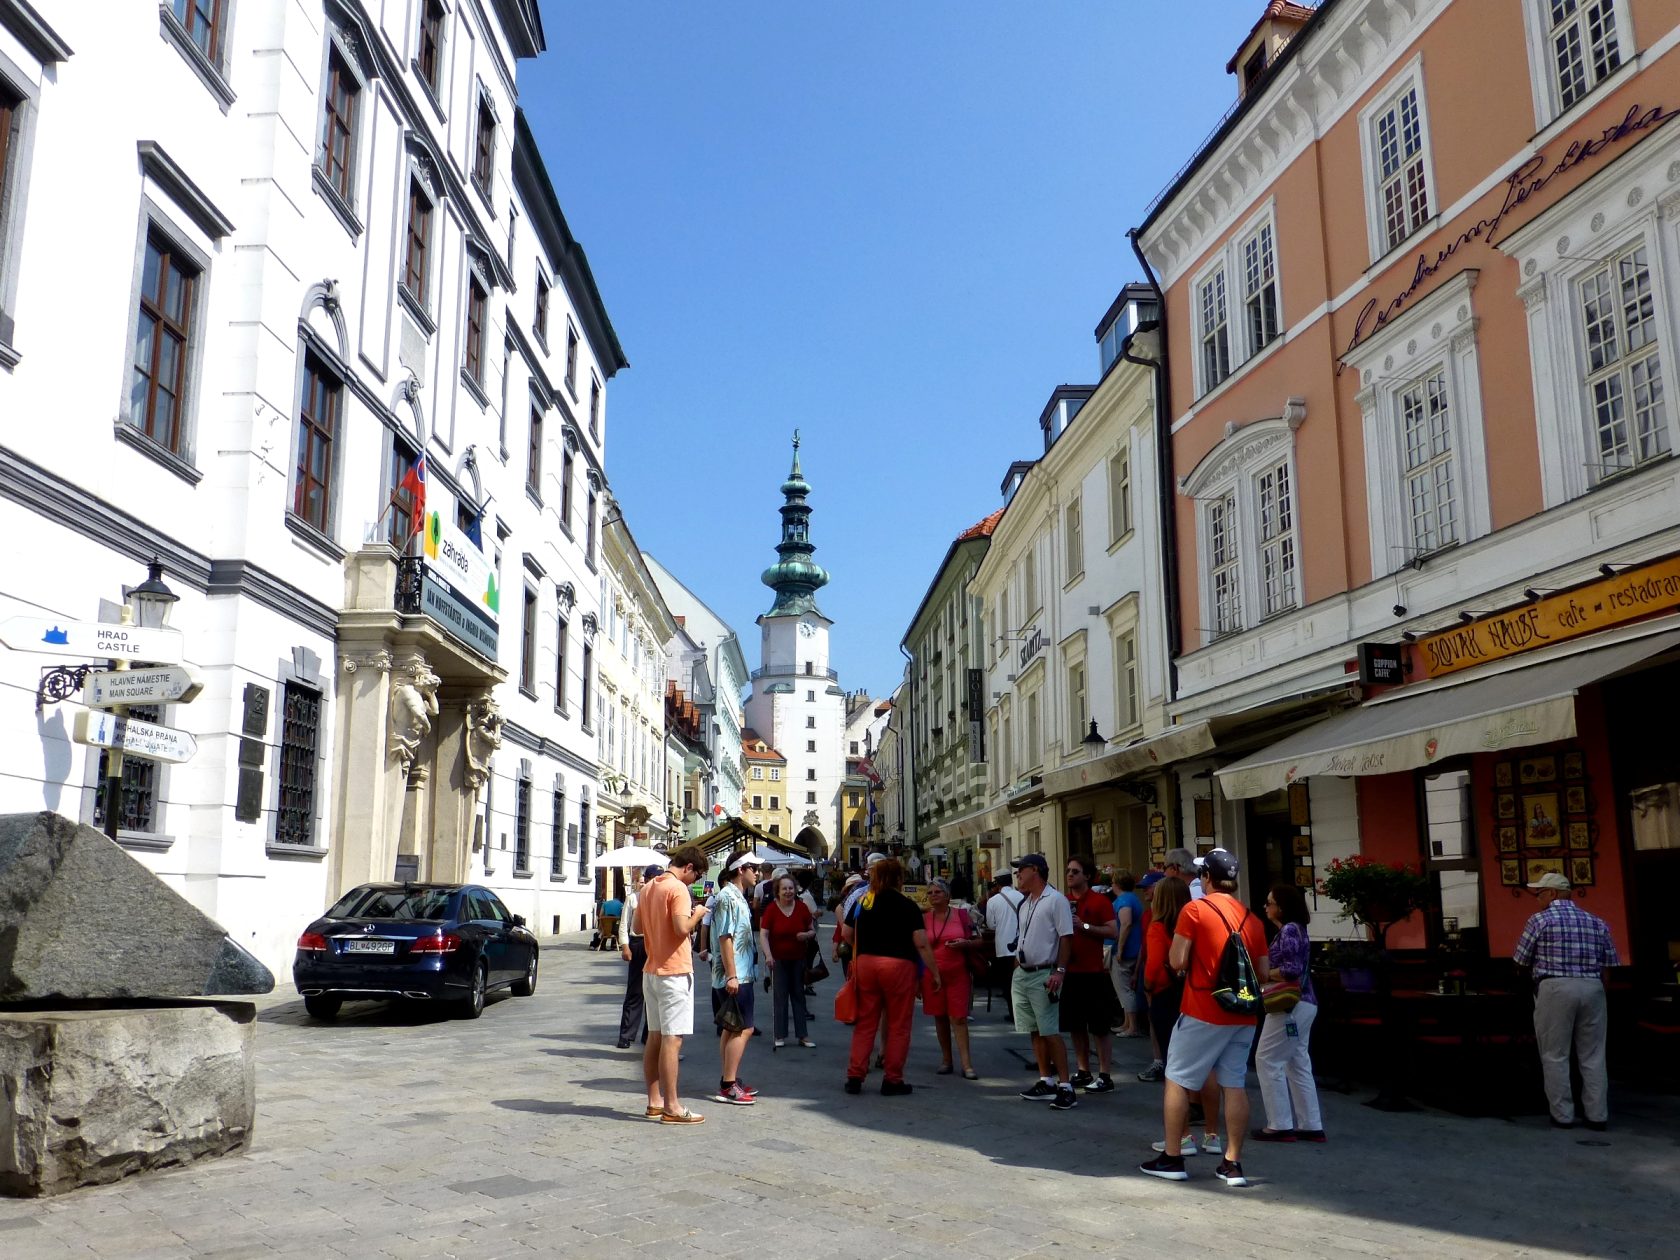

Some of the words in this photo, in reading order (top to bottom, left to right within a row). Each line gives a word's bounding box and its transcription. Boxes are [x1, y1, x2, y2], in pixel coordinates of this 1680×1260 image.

[97, 630, 129, 641] HRAD
[1427, 628, 1487, 673] SLOVAK
[1488, 608, 1550, 650] HAUSE
[97, 642, 140, 653] CASTLE
[110, 675, 136, 687] HLAVNÉ
[136, 672, 171, 684] NÁMESTIE
[109, 688, 125, 698] MAIN
[126, 687, 154, 697] SQUARE
[971, 672, 980, 720] HOTEL
